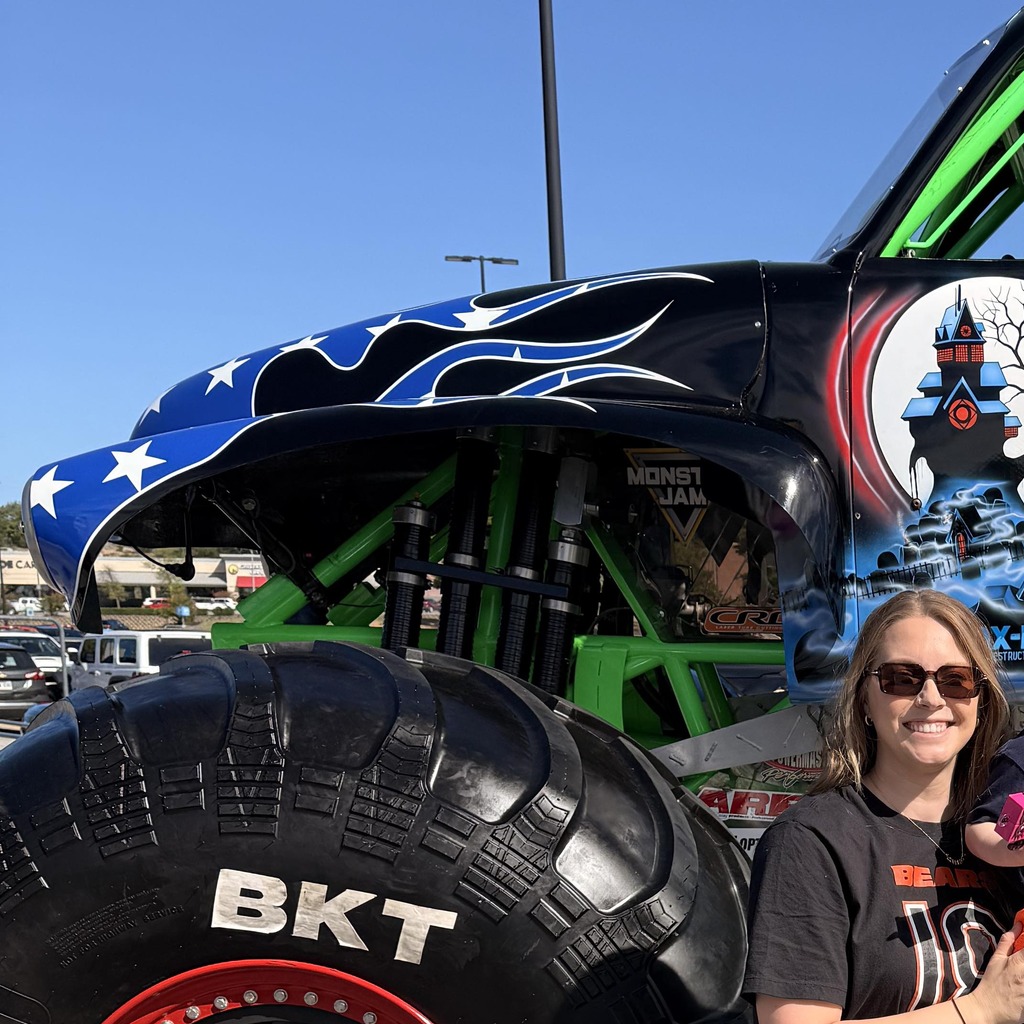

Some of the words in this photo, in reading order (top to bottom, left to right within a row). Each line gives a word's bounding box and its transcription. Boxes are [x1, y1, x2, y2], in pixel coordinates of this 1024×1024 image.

[627, 467, 701, 485] MONST
[658, 487, 707, 505] JAM
[210, 868, 458, 964] BKT
